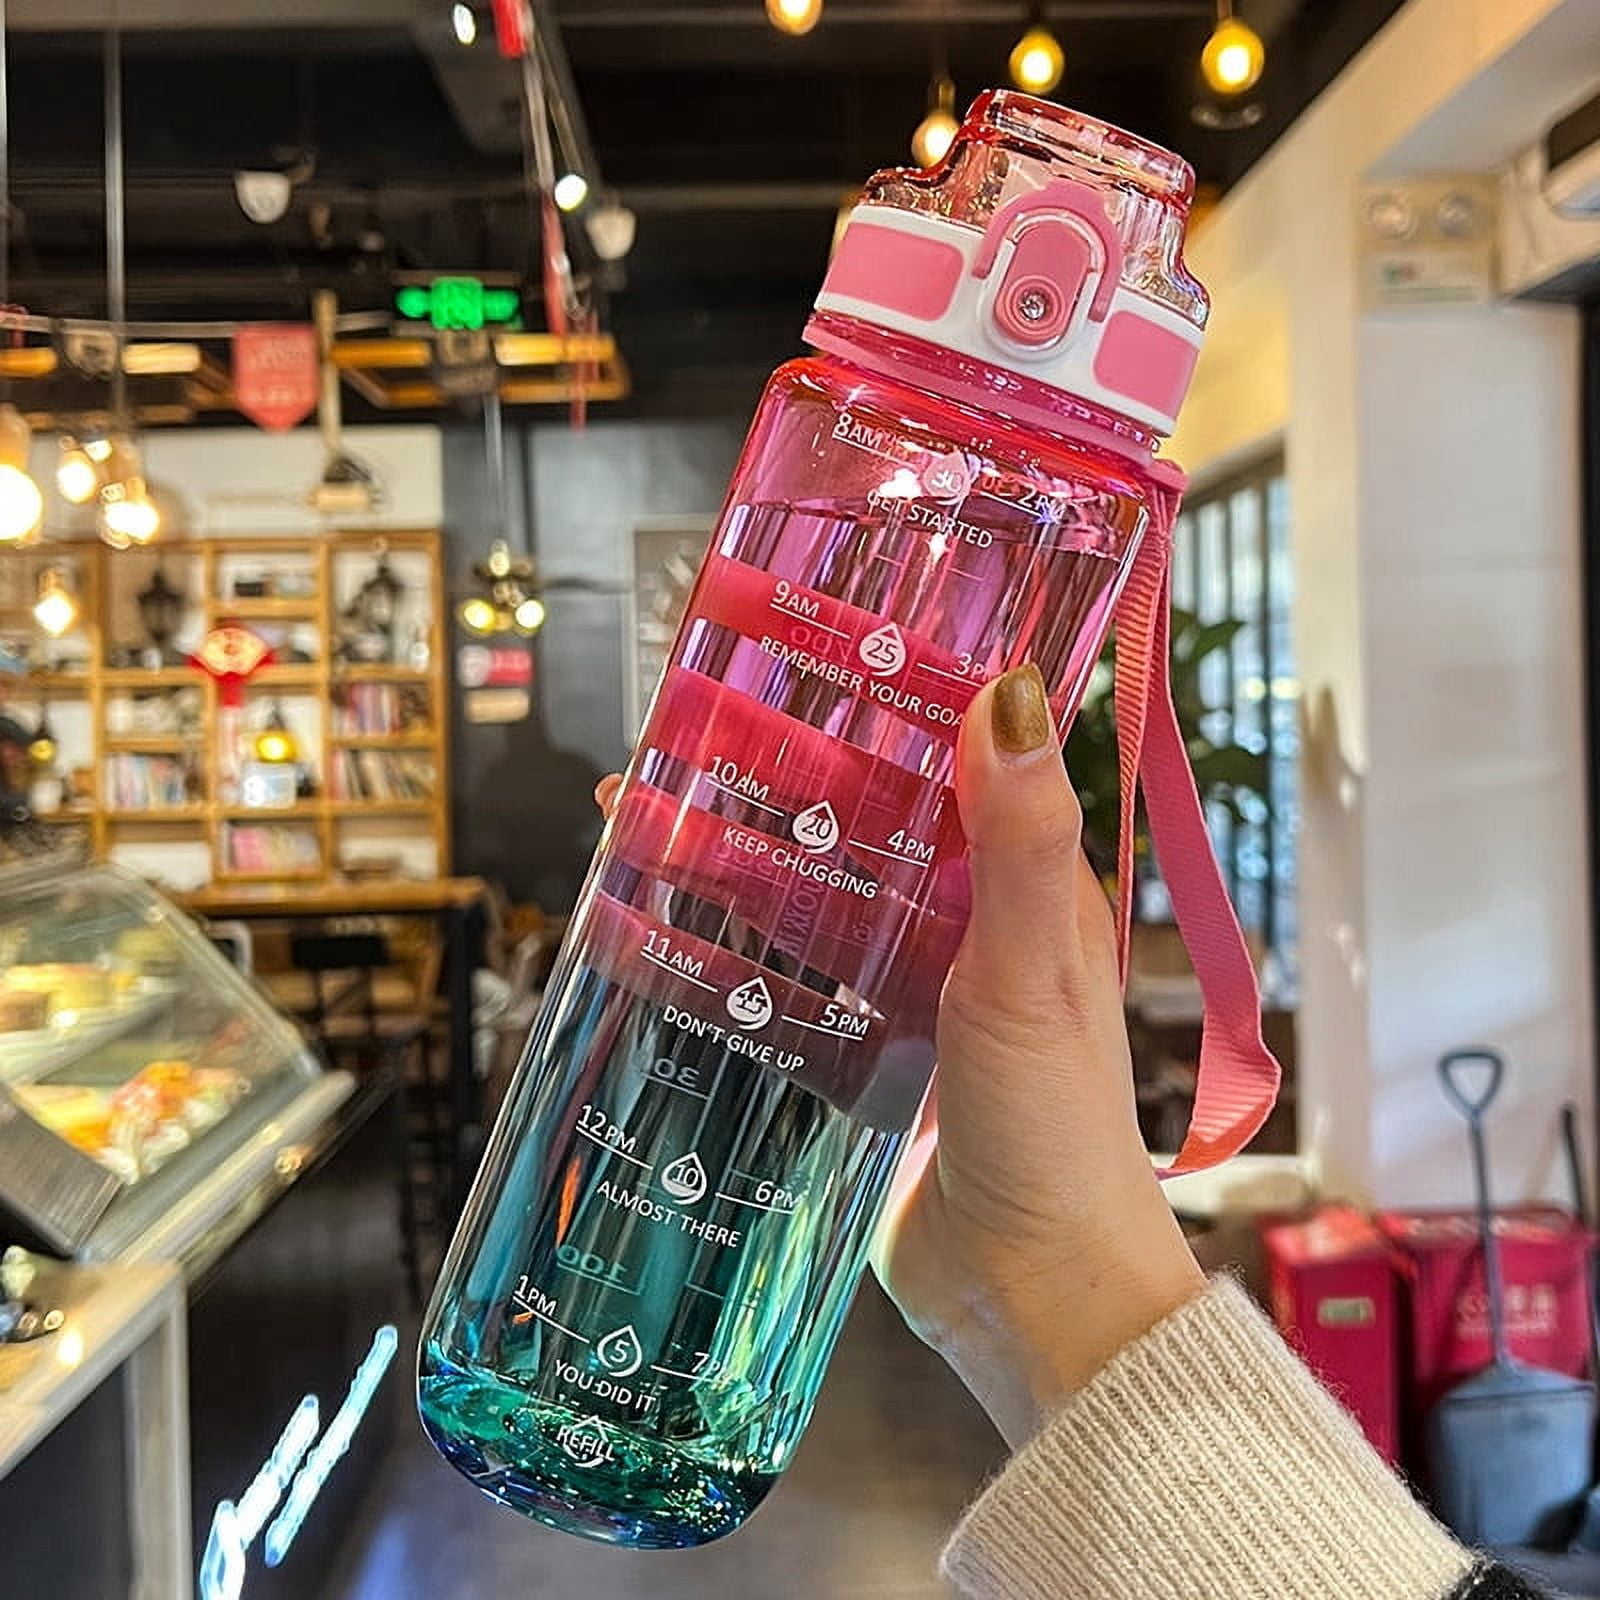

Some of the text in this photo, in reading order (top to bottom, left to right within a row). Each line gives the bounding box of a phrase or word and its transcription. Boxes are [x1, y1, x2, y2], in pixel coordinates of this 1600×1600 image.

[834, 412, 881, 449] 8AM
[907, 503, 993, 549] STARTED
[772, 580, 820, 618] 9AM
[866, 637, 899, 665] 25
[761, 636, 865, 693] REMEMBER
[868, 680, 922, 714] YOUR
[708, 756, 770, 801] 10AM
[801, 814, 833, 840] 20
[887, 829, 935, 862] 4PM
[723, 827, 769, 857] KEEP
[771, 848, 879, 898] CHUGGING
[643, 930, 704, 977] 11AM
[737, 988, 768, 1015] 15
[820, 1004, 870, 1036] 5PM
[663, 1005, 805, 1072] DON'T GIVE UP
[577, 1104, 637, 1155] 12PM
[672, 1163, 699, 1188] 10
[597, 1181, 742, 1248] ALMOST THERE
[513, 1275, 557, 1317] 1PM
[609, 1340, 630, 1363] 5
[554, 1359, 656, 1412] YOU DID IT
[556, 1424, 615, 1461] REFILL
